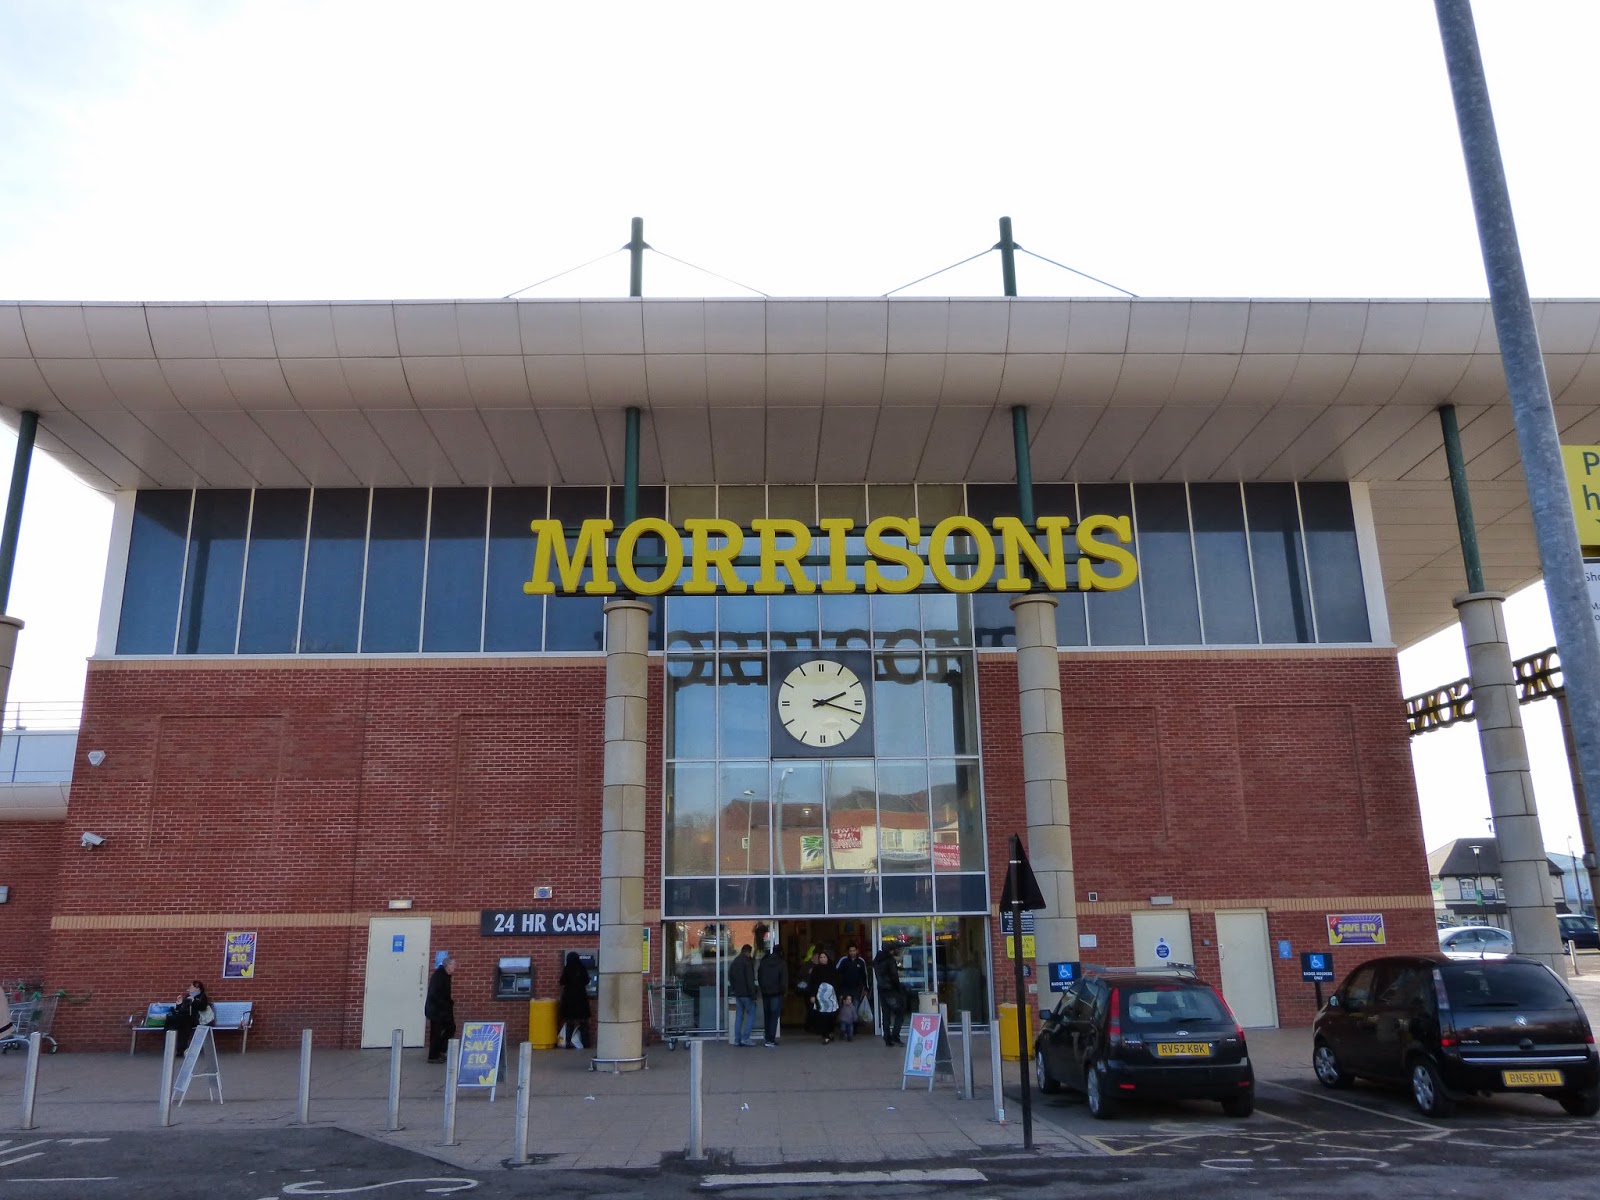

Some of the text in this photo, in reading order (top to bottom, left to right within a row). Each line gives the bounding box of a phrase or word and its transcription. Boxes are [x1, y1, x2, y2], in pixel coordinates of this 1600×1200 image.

[523, 515, 1138, 596] MORRISONS
[494, 912, 600, 933] 24 HR CASH
[1338, 923, 1376, 932] SAVE £10
[228, 944, 251, 953] SAVE
[231, 953, 247, 962] £10
[464, 1040, 495, 1052] SAVE
[1161, 1044, 1206, 1054] RV52 KBK
[467, 1053, 488, 1064] £10
[1509, 1073, 1536, 1083] BN56
